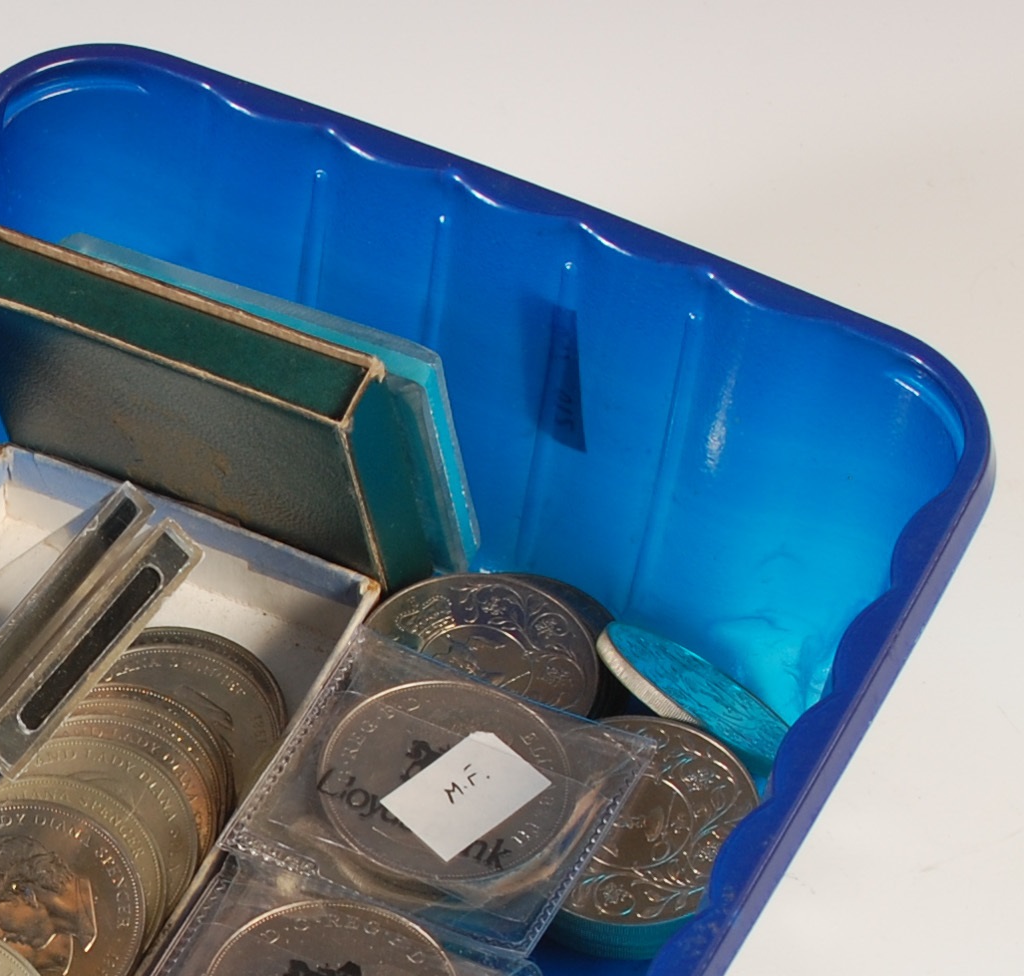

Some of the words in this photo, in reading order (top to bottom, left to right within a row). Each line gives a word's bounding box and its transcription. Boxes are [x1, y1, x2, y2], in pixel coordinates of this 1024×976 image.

[86, 749, 136, 772] LADY
[317, 768, 406, 829] Lloy
[33, 814, 93, 849] DIANA
